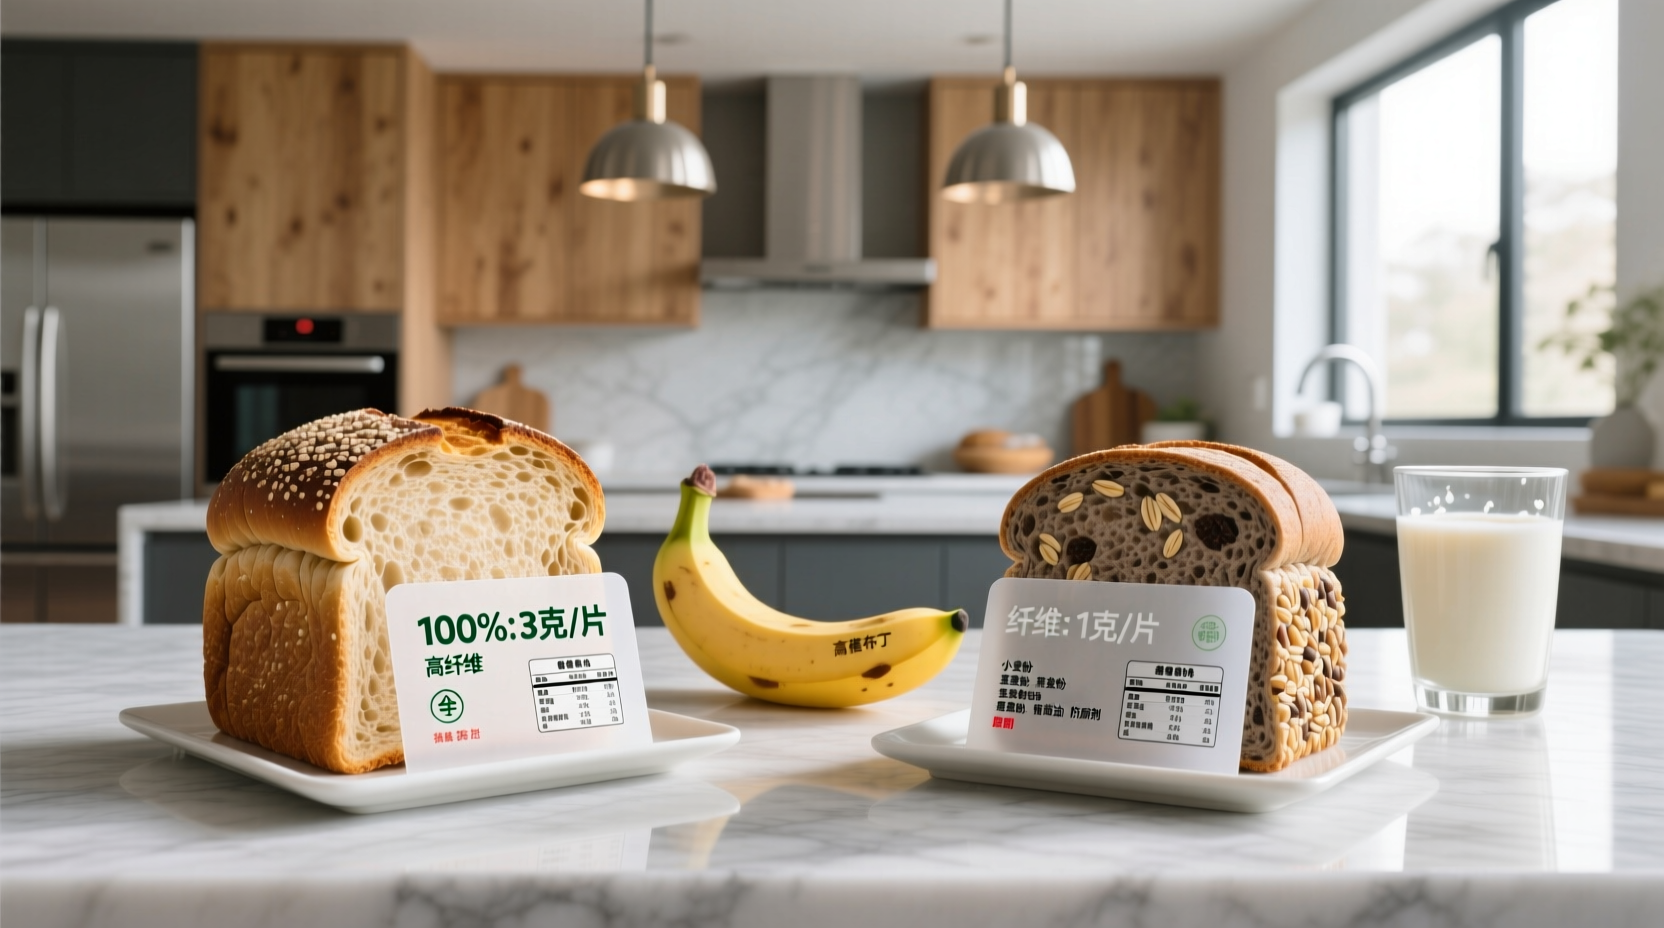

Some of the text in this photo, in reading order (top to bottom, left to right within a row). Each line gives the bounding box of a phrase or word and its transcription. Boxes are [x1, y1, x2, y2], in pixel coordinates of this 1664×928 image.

[417, 604, 607, 646] 100%:3克/片
[424, 652, 484, 678] 高纤维
